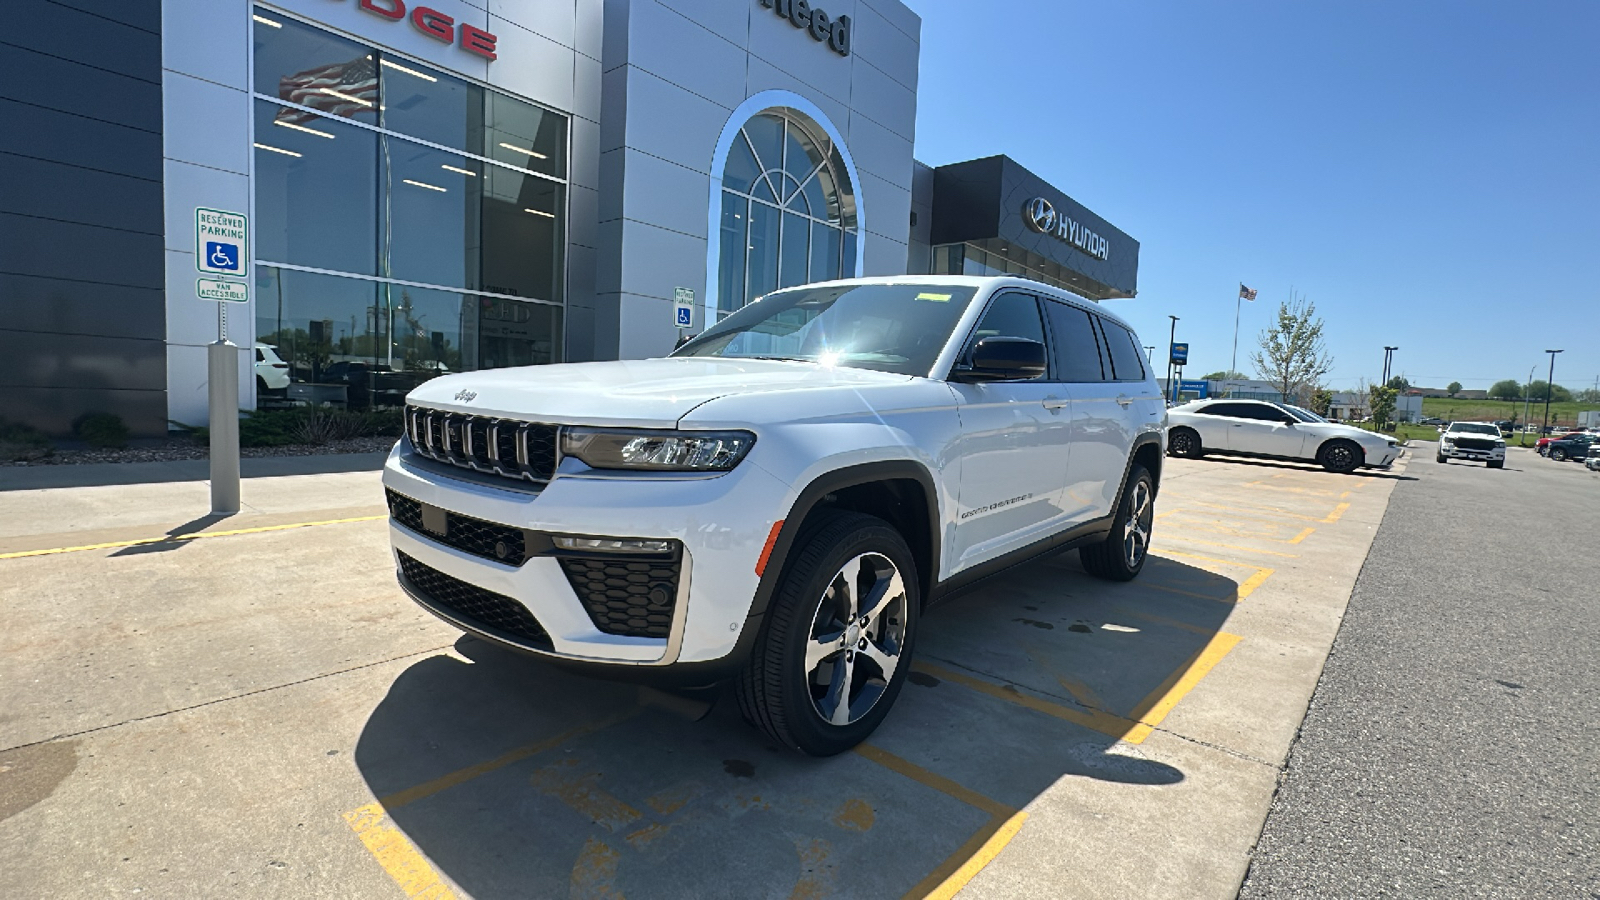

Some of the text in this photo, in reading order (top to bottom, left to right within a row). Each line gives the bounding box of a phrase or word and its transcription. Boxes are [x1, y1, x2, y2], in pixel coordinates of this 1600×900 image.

[320, 0, 498, 62] DGE
[201, 213, 243, 228] RESERVED
[201, 224, 244, 239] PARKING
[1058, 212, 1109, 261] HYUNDAI
[201, 289, 245, 298] ACCESSIBLE
[216, 283, 231, 291] VAN
